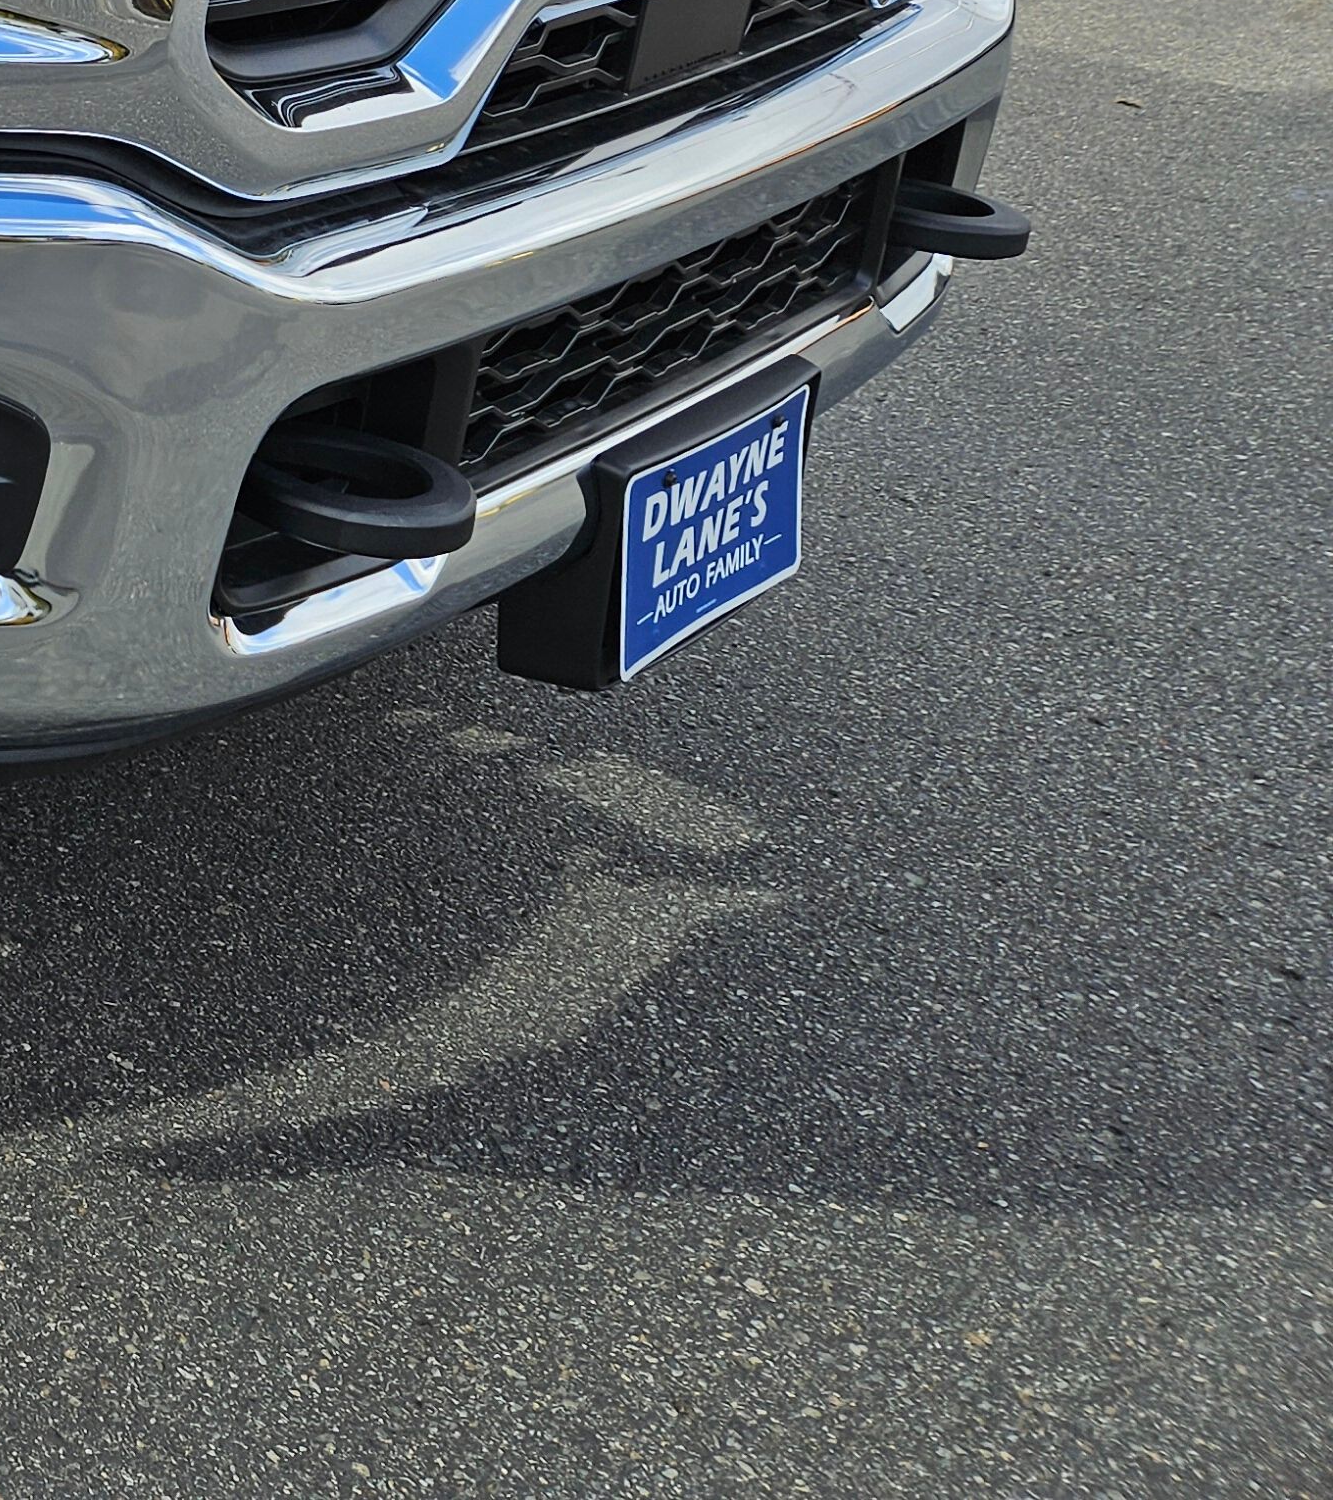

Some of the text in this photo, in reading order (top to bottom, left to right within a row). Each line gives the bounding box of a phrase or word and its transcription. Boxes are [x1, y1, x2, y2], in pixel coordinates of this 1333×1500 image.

[642, 420, 789, 543] DWAYNE
[652, 480, 769, 589] LANE'S
[652, 533, 764, 624] AUTO FAMILY
